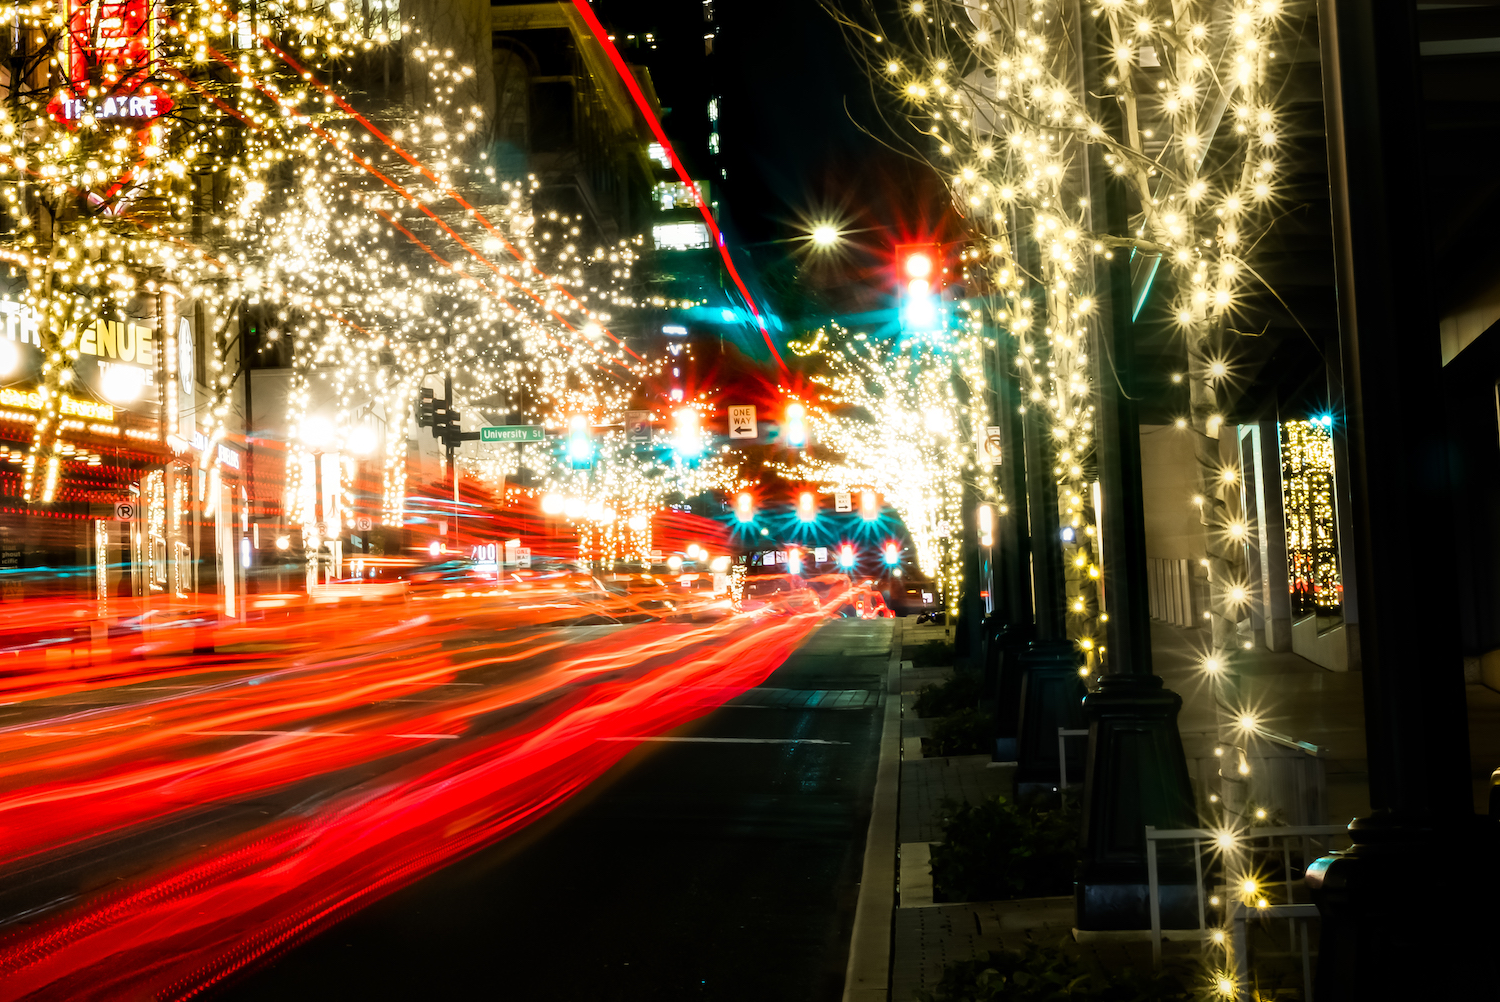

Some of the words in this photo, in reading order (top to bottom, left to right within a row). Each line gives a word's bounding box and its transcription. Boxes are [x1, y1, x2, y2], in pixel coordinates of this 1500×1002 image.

[733, 417, 752, 425] WAY
[483, 429, 527, 439] University
[532, 429, 541, 438] St
